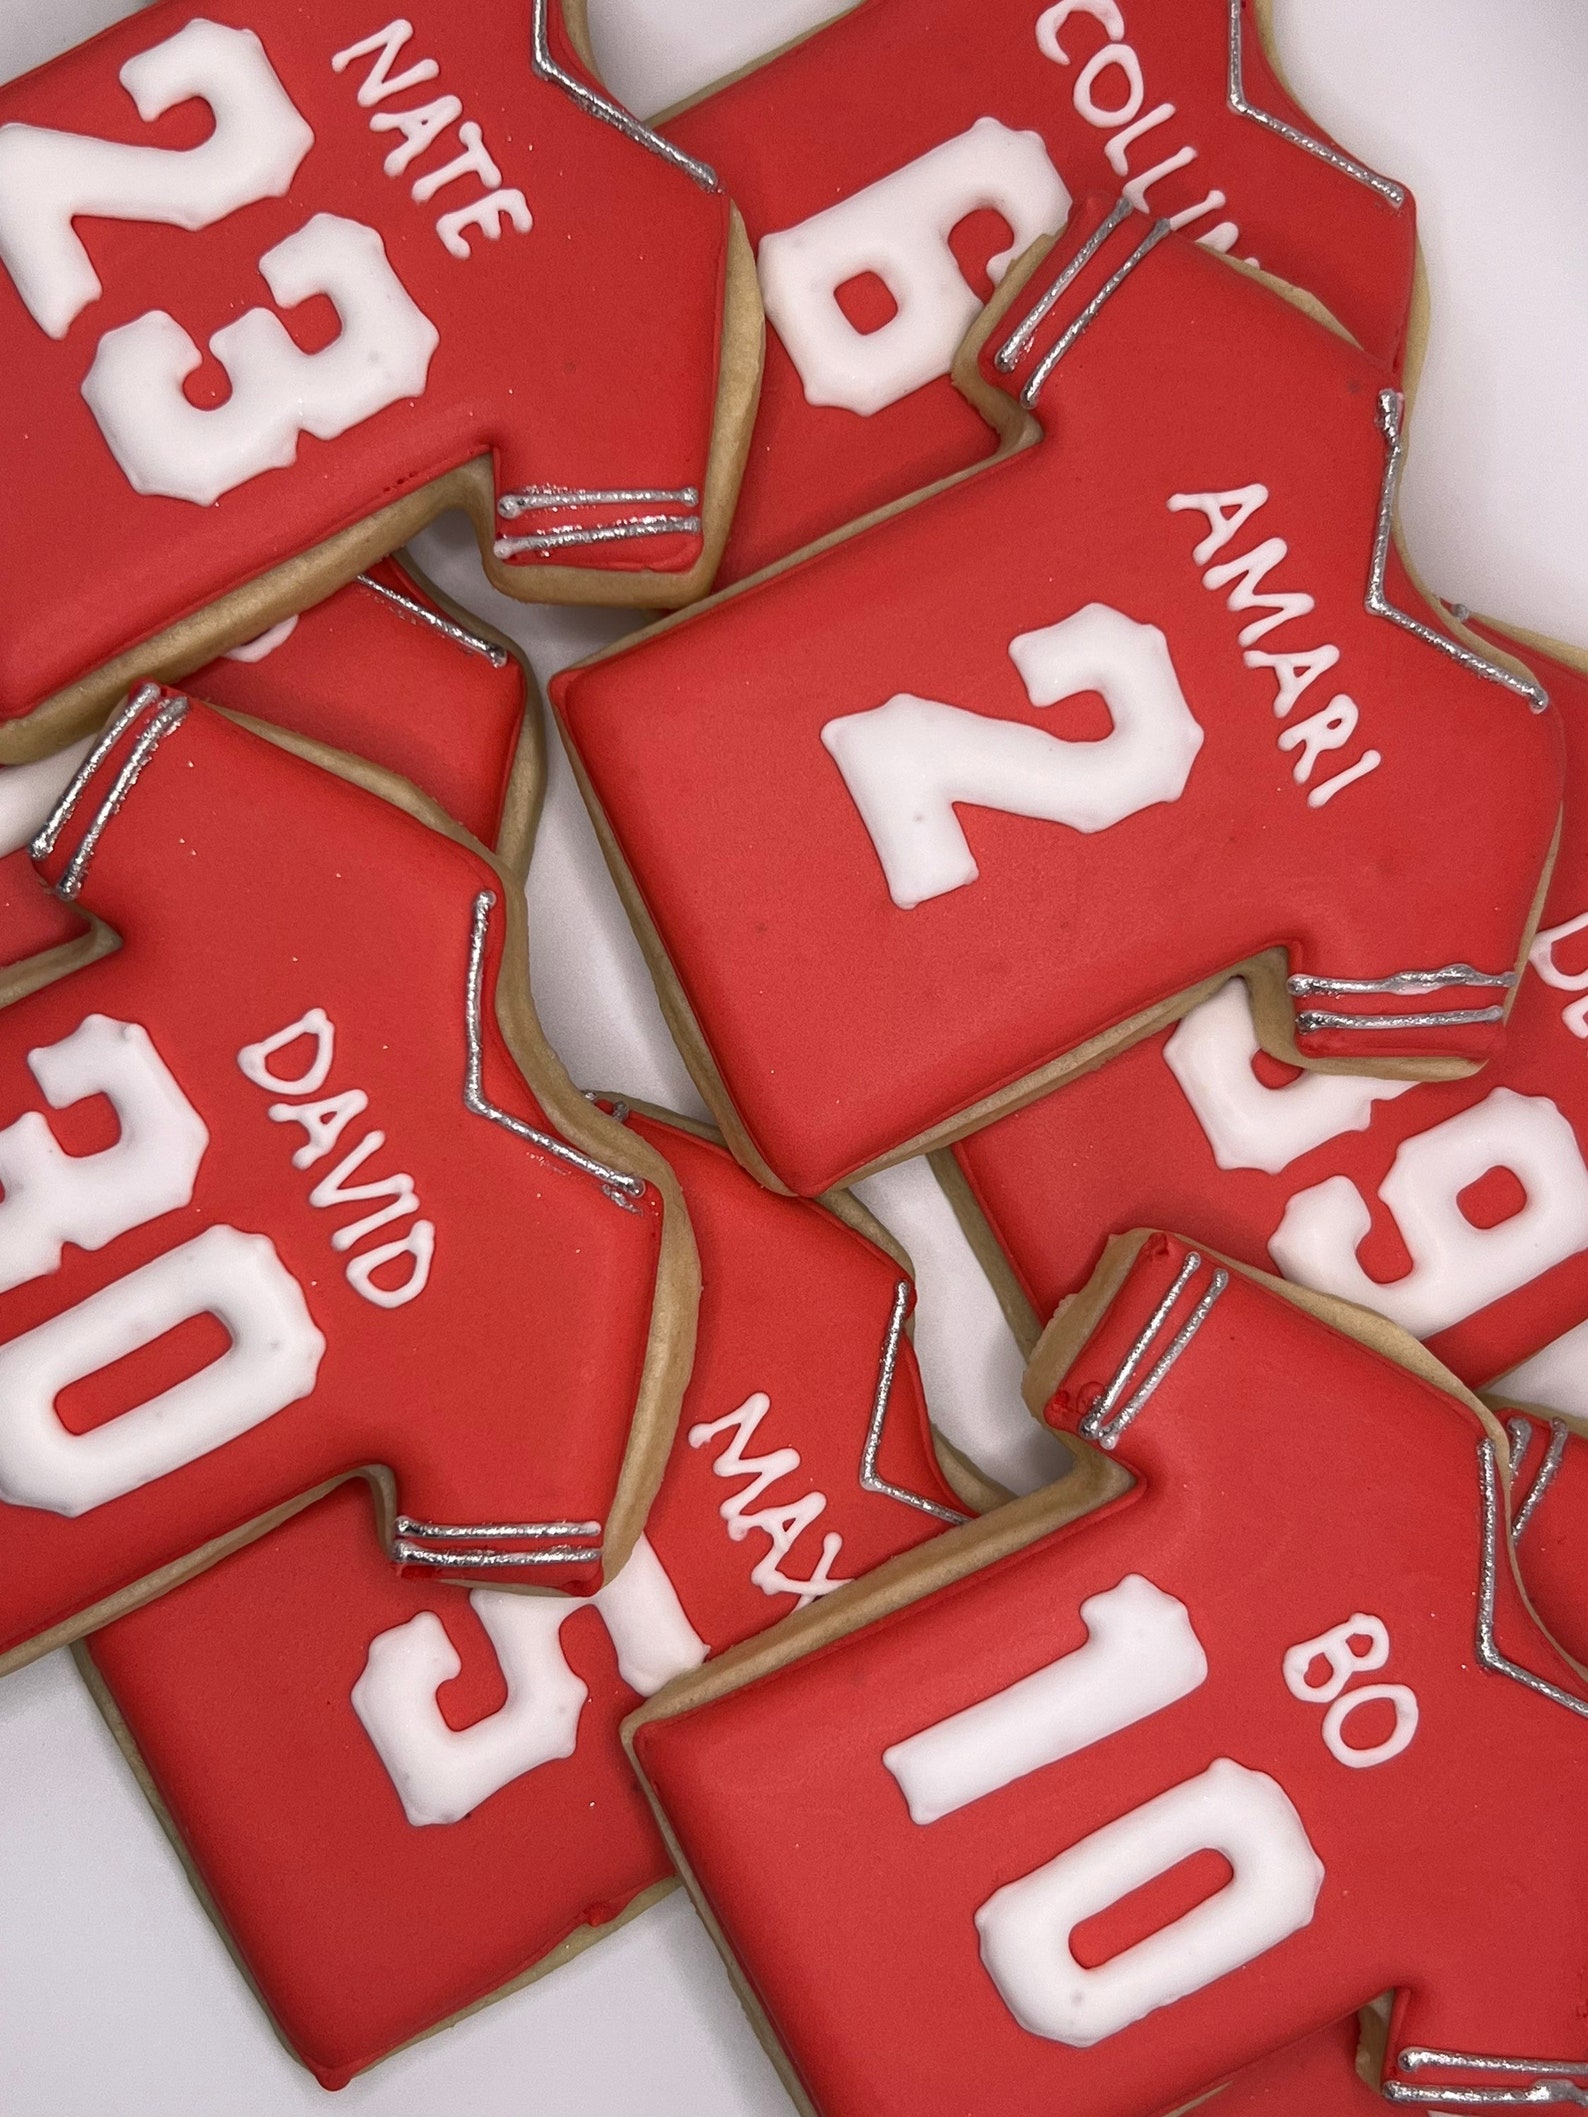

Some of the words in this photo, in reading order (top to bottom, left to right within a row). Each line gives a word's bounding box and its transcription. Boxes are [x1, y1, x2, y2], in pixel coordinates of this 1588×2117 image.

[0, 17, 440, 507] 23
[329, 17, 534, 259] NATE
[758, 115, 1074, 416] 6
[1035, 0, 1259, 268] COLLI
[820, 601, 1205, 910] 2
[1167, 482, 1382, 808] AMARI
[0, 1012, 326, 1518] 30
[236, 1007, 435, 1310] DAVID
[688, 1392, 856, 1614] MAX
[882, 1573, 1326, 2049] 10
[1282, 1612, 1420, 1770] BO
